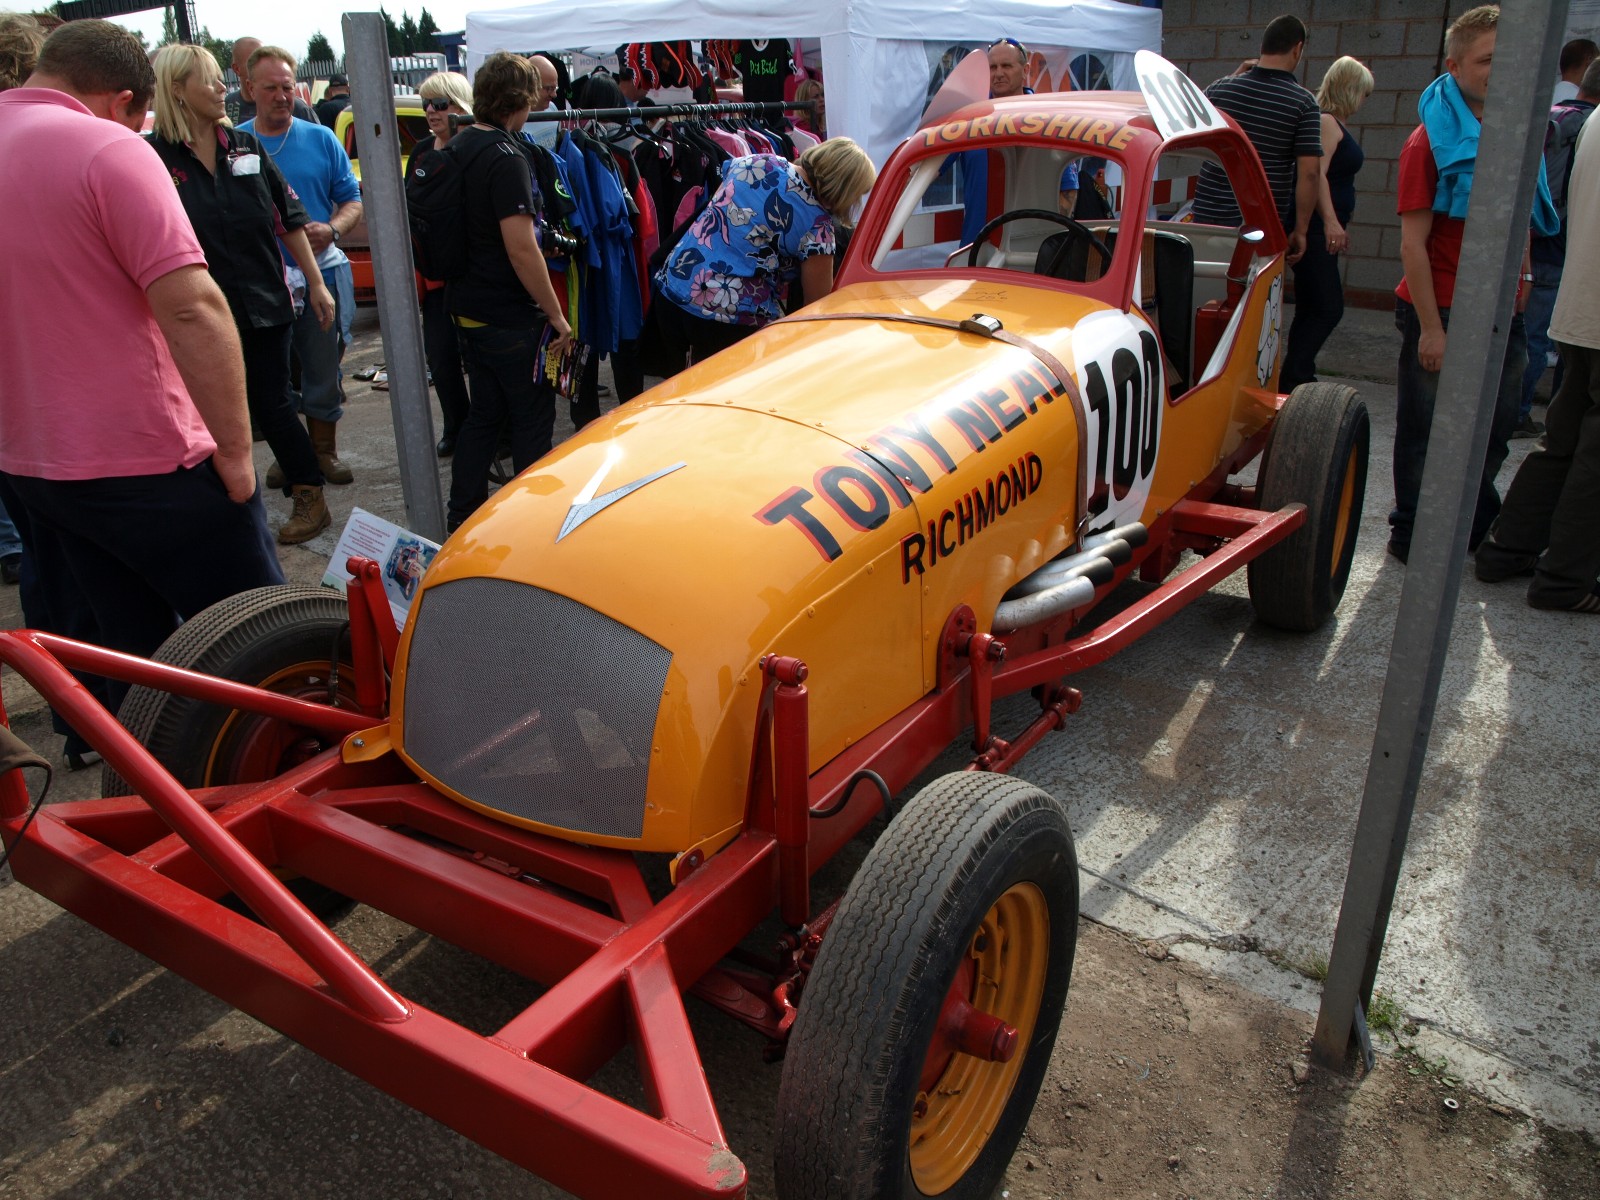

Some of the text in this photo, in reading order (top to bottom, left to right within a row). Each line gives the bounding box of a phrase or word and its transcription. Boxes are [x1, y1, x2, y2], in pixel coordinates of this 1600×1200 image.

[750, 59, 760, 77] Pit
[1141, 69, 1213, 133] 100
[920, 112, 1142, 150] YORKSHIRE
[1084, 330, 1160, 515] 100
[751, 405, 957, 564] TONY
[900, 451, 1043, 585] RICHMOND
